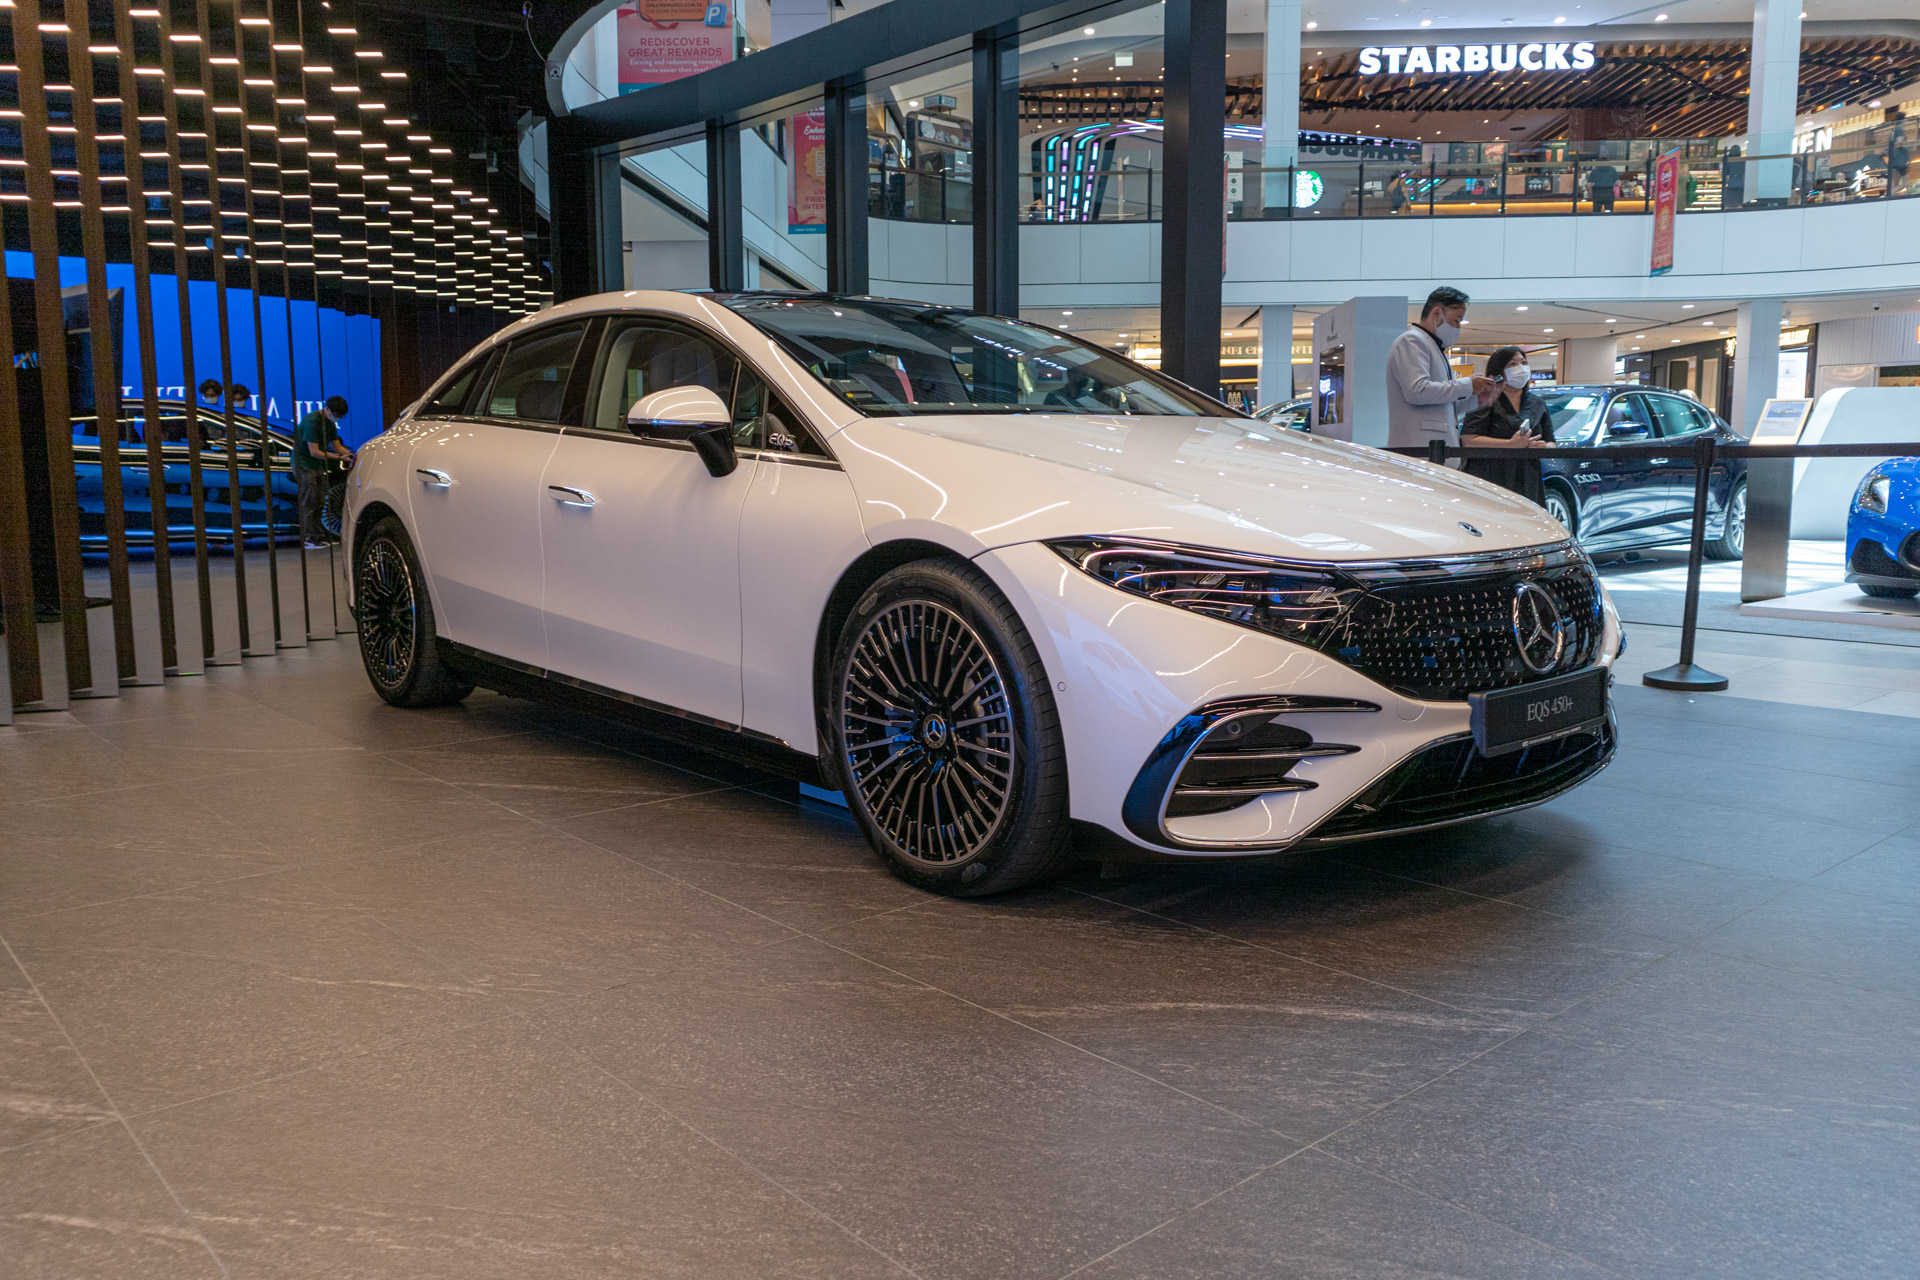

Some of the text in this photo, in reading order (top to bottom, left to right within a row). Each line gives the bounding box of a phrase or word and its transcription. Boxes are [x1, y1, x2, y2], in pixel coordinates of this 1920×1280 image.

[640, 37, 710, 46] REDISCOVER
[628, 48, 722, 57] GREAT REWARDS
[629, 59, 653, 67] Earning
[666, 59, 697, 67] redeeming
[1358, 42, 1595, 75] STARBUCKS
[769, 433, 796, 447] EQS
[1527, 695, 1574, 722] EQS 450+
